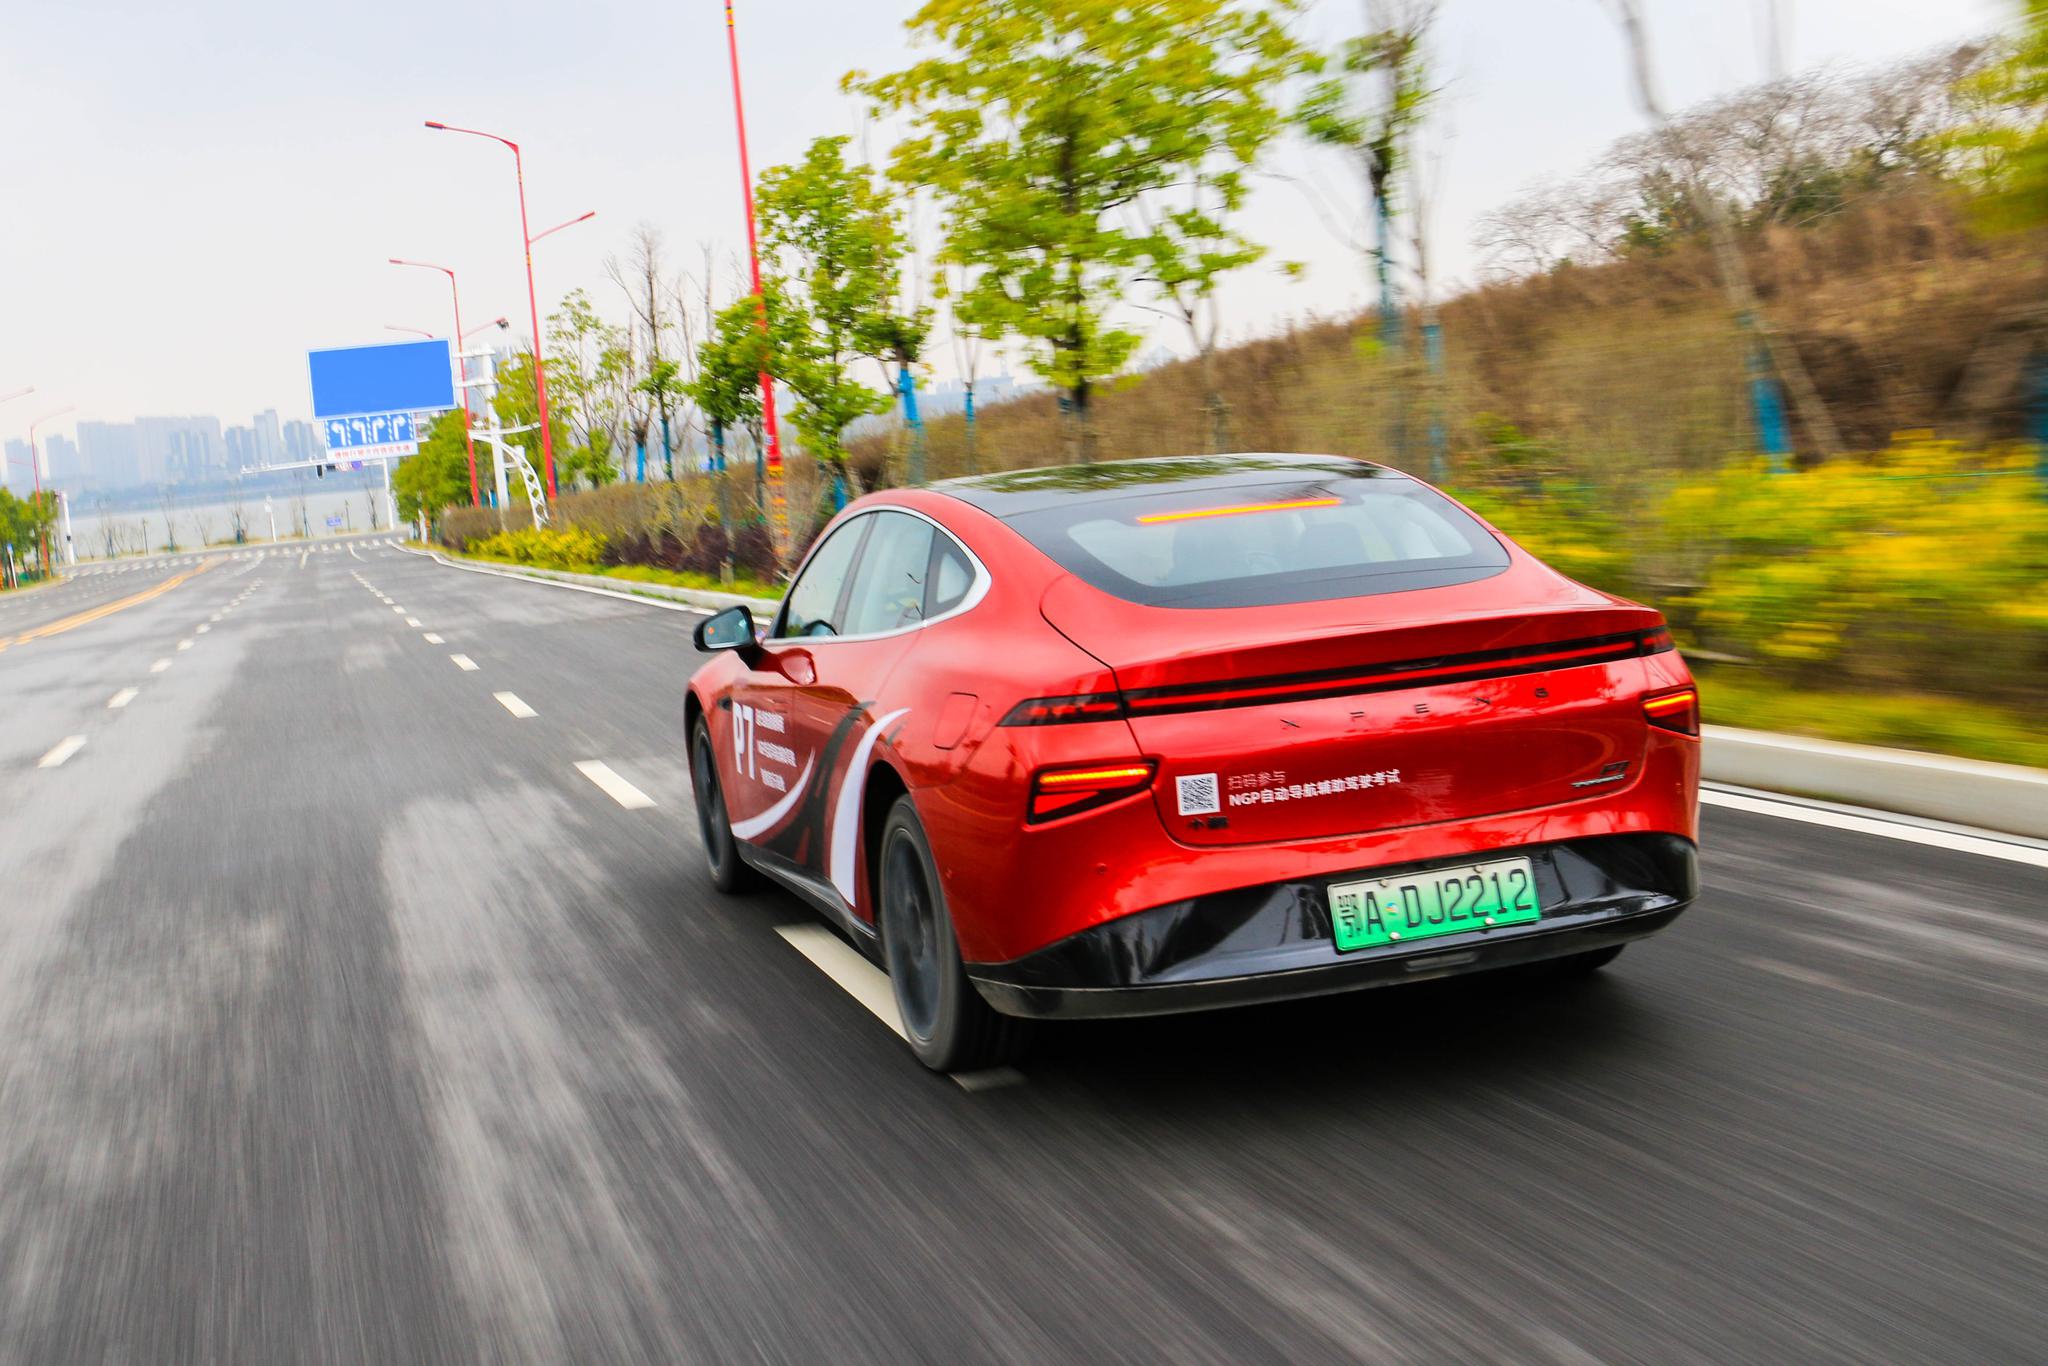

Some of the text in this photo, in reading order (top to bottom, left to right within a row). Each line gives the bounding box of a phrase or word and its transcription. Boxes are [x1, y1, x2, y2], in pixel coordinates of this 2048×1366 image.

[733, 701, 755, 780] P7
[1227, 770, 1286, 790] 扫码参与
